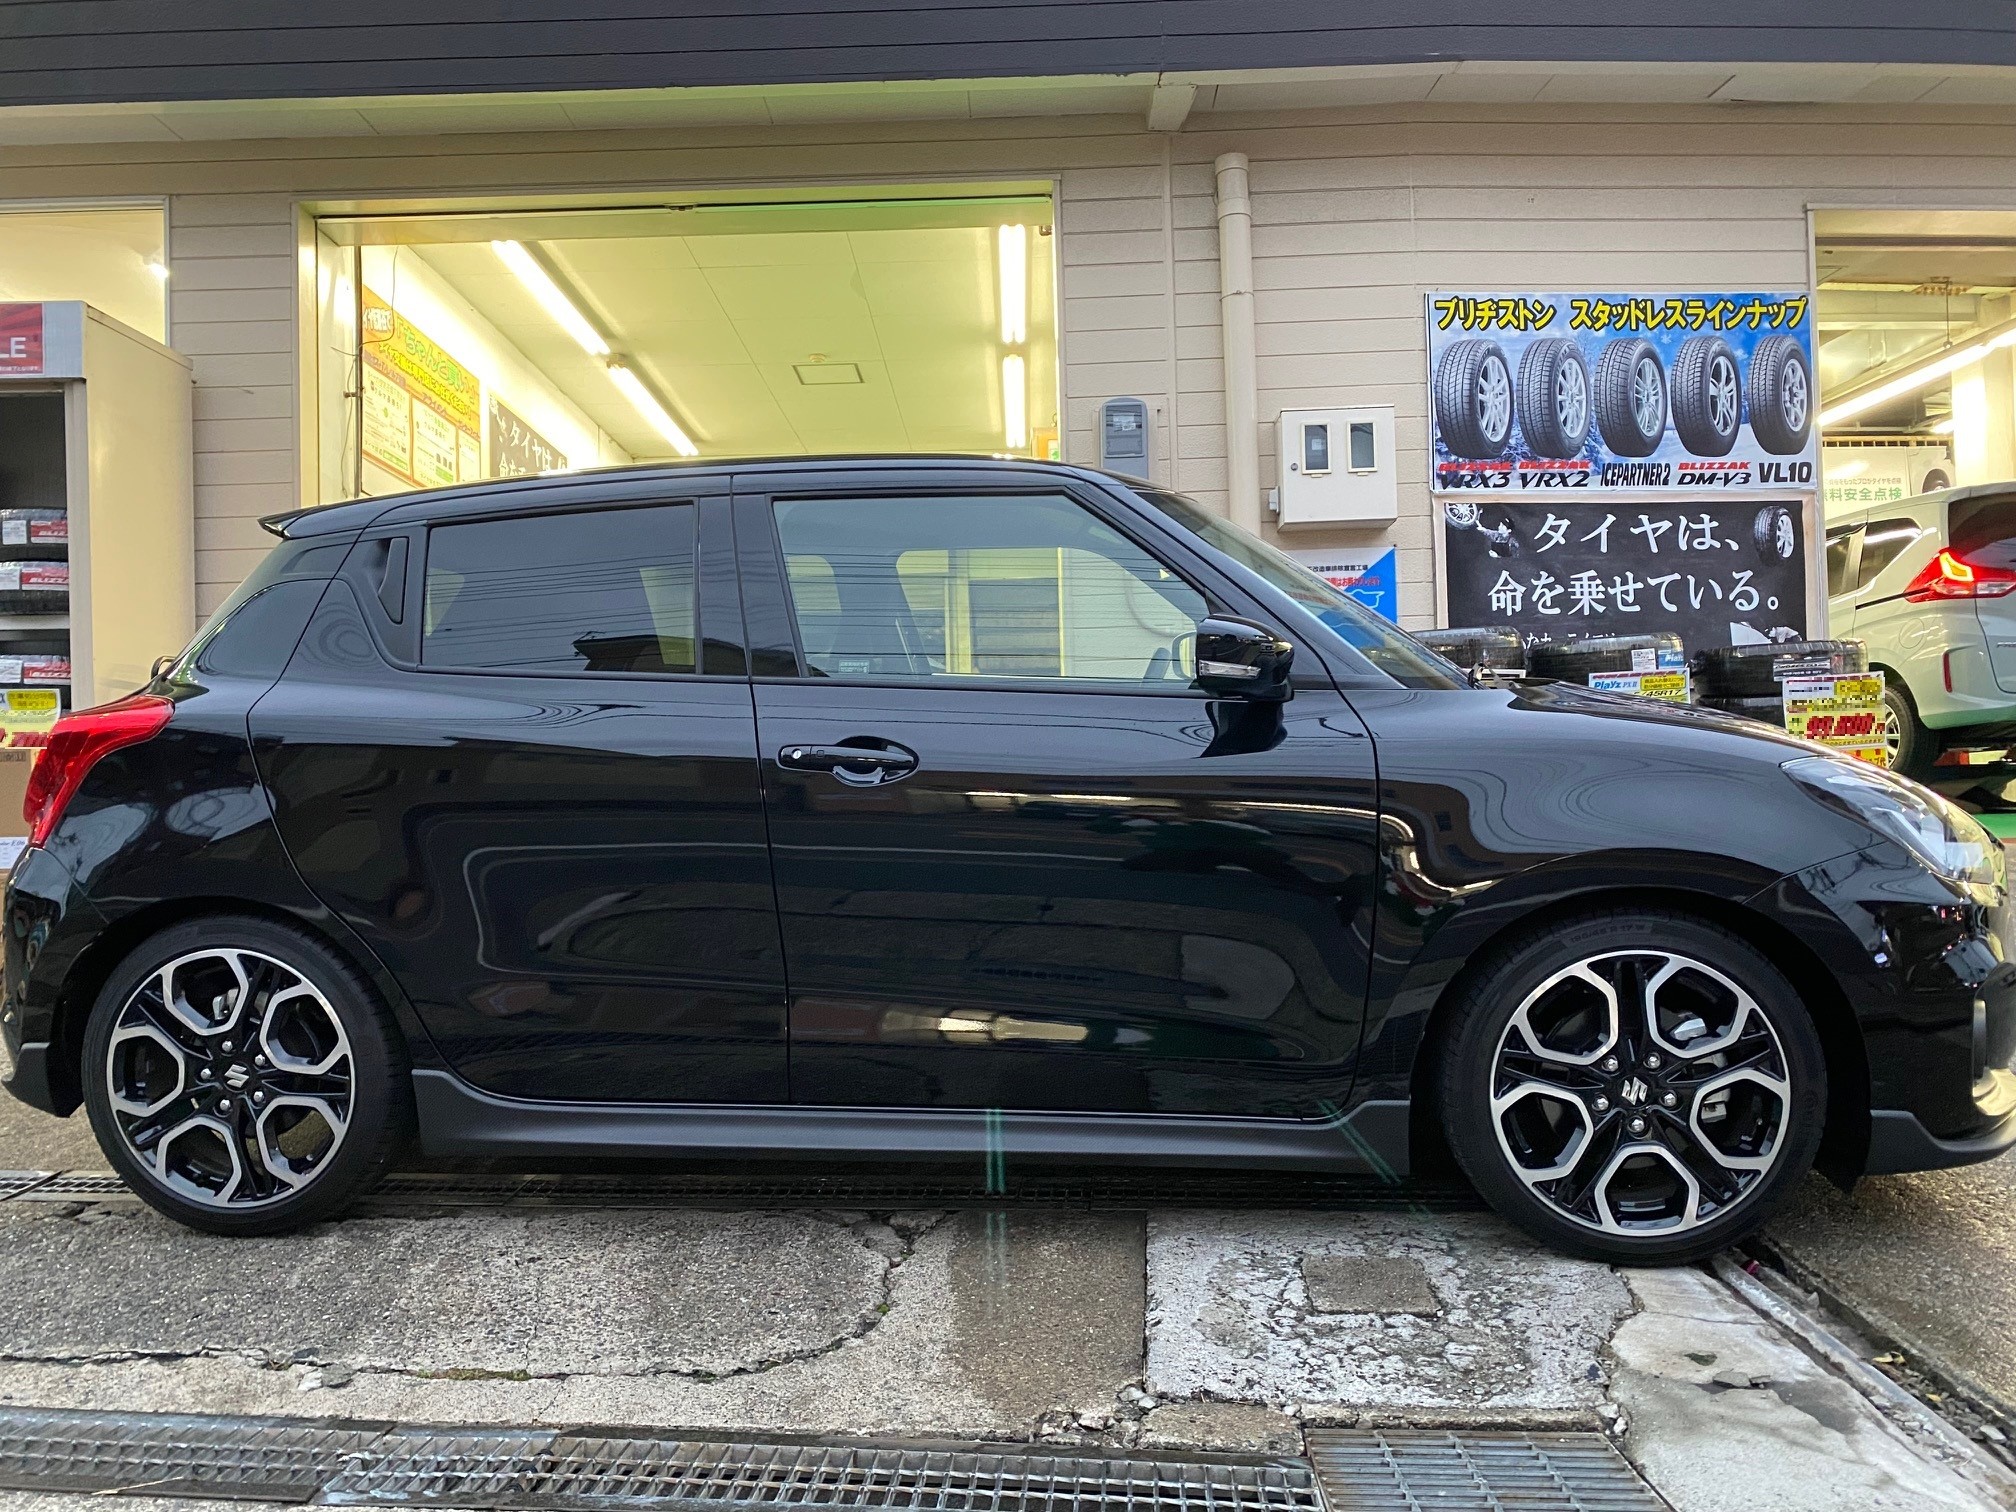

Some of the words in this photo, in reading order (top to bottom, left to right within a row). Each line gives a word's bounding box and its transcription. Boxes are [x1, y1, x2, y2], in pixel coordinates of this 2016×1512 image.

[1434, 295, 1557, 331] ブリヂストン
[1569, 294, 1809, 331] スタッドレスラインナップ
[1677, 461, 1751, 471] BLIZZAK
[1758, 461, 1813, 484] VL10
[1440, 471, 1512, 489] VRX3
[1519, 471, 1590, 489] VRX2
[1677, 472, 1751, 489] DM-V3
[1533, 512, 1740, 554] タイヤは、
[1487, 568, 1781, 616] 命を乗せている。
[1594, 681, 1621, 690] Playz
